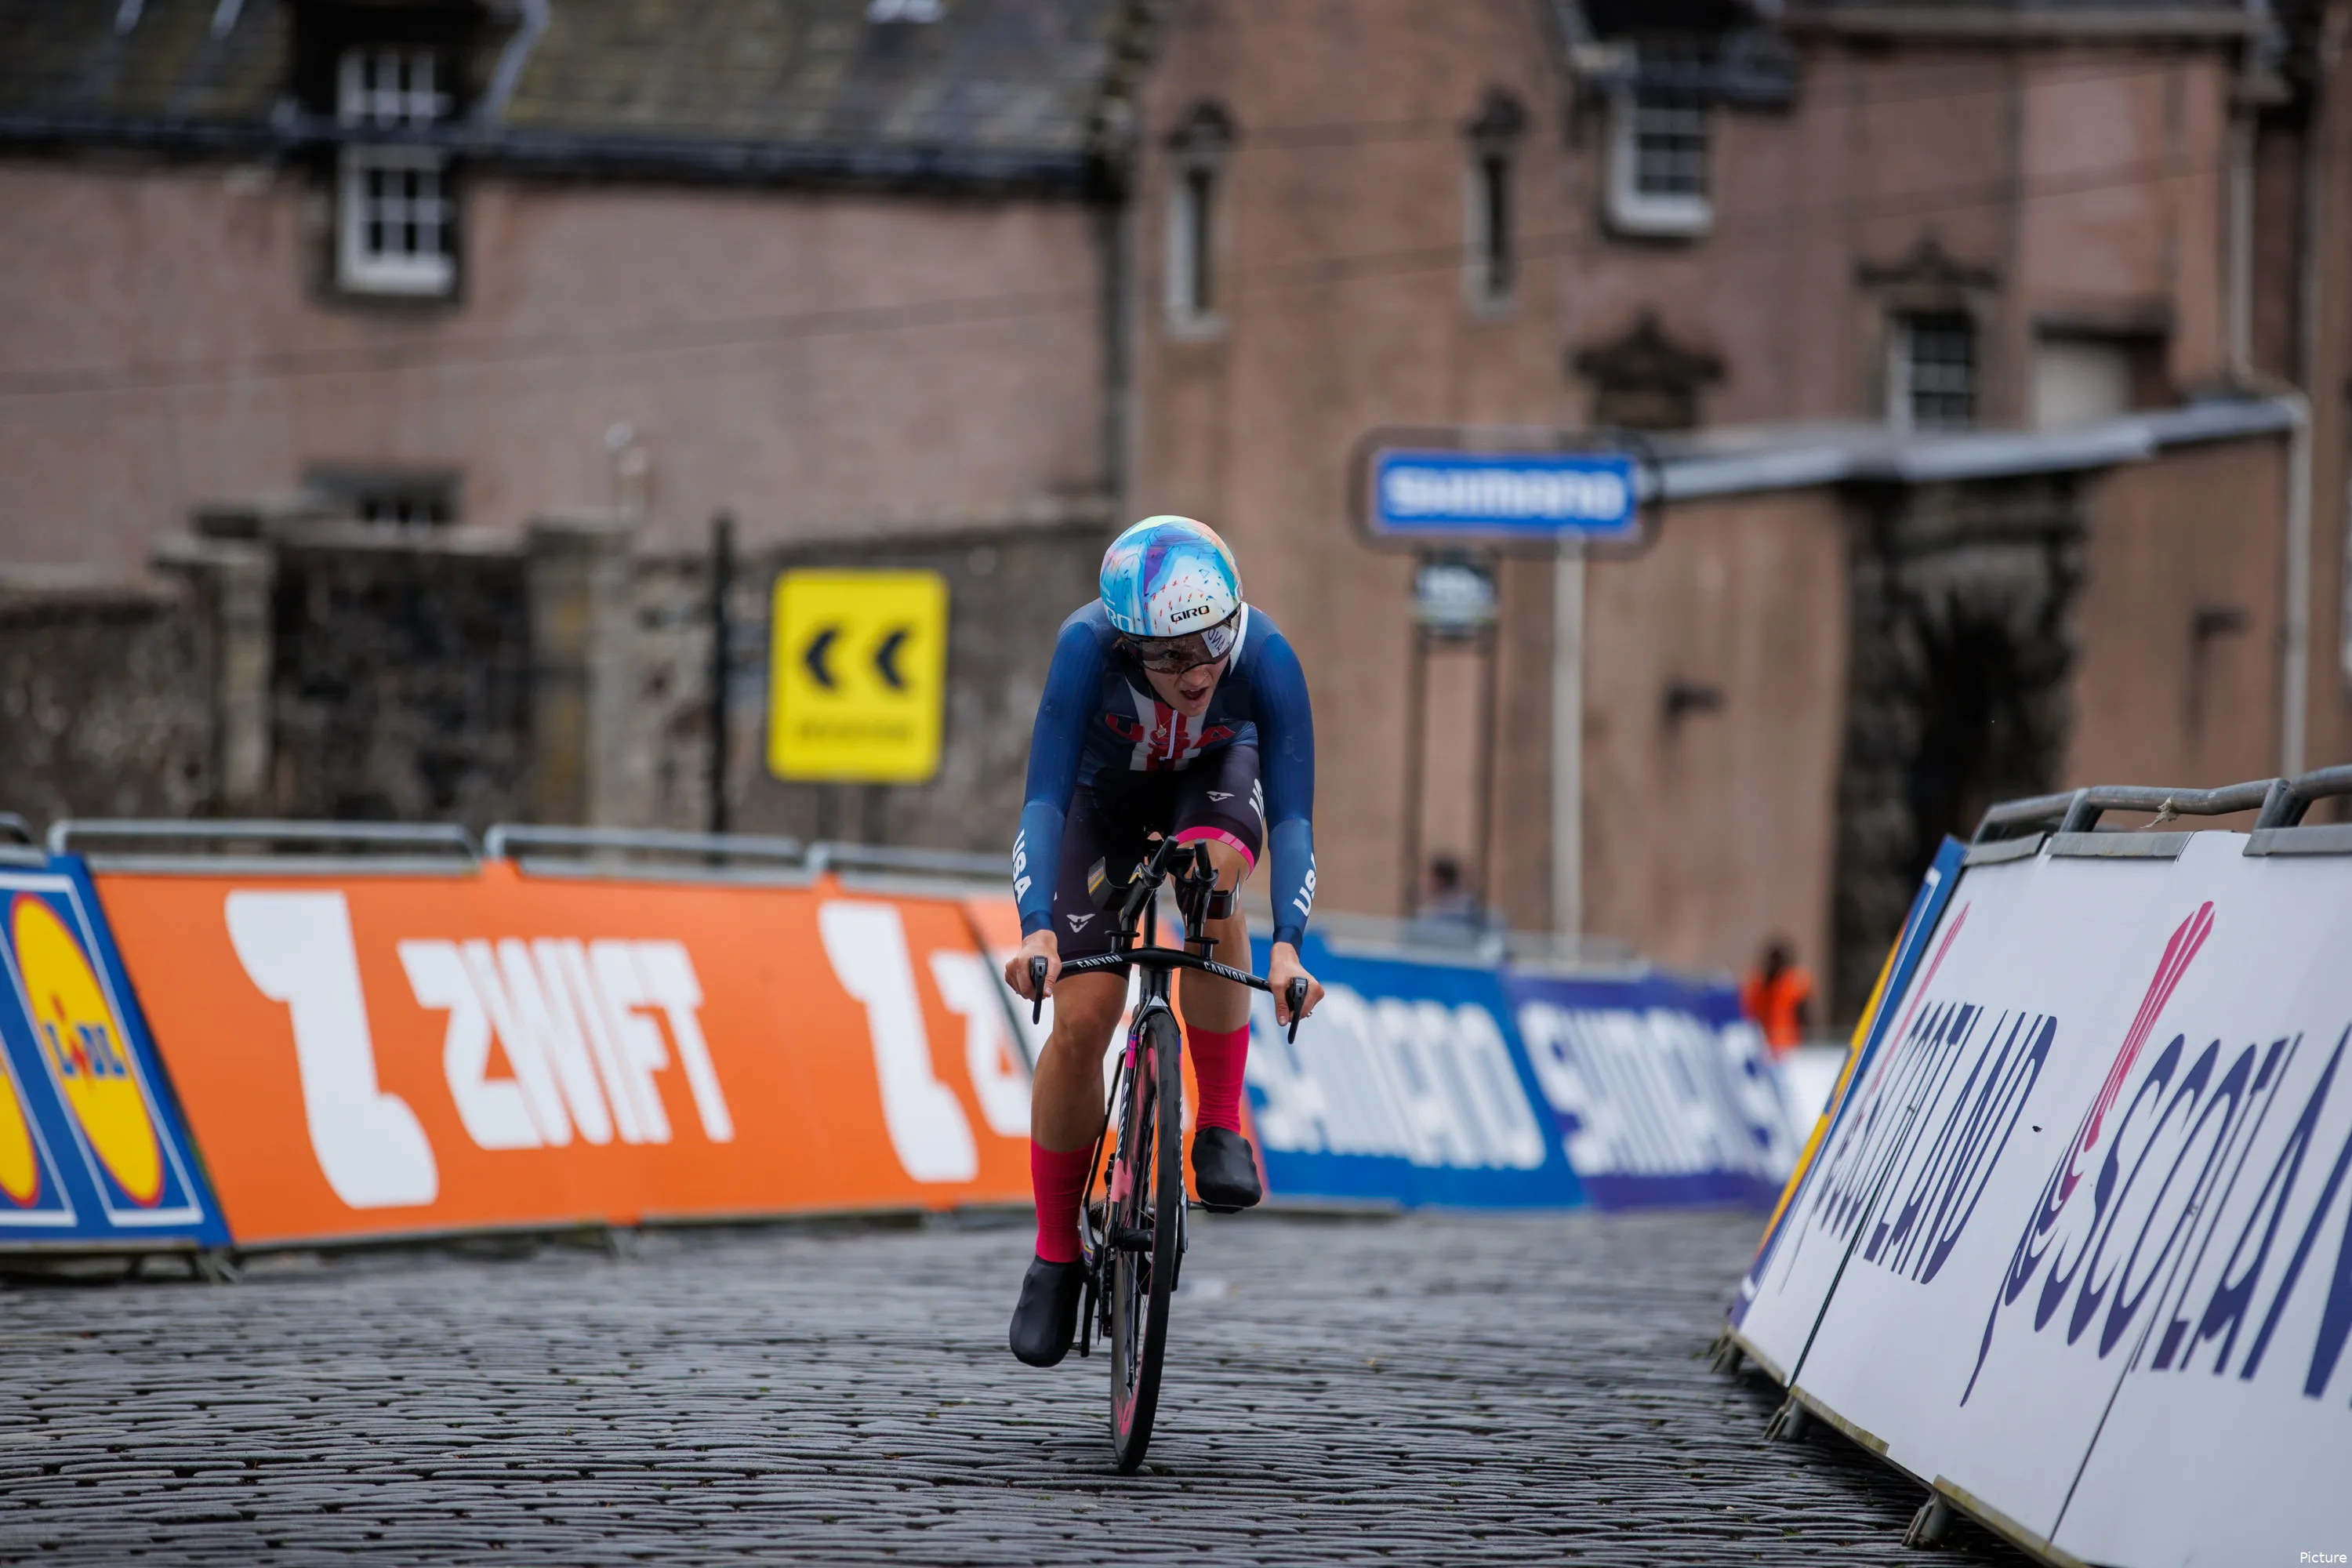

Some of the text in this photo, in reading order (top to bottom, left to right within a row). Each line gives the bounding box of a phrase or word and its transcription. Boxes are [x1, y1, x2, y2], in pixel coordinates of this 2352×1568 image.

[1170, 604, 1210, 623] GIRO
[1105, 713, 1236, 751] USA
[1012, 828, 1033, 905] USA
[1076, 954, 1123, 968] CANYON
[1203, 961, 1247, 983] CANYON
[395, 936, 735, 1150] ZWIFT
[2035, 1022, 2352, 1402] SCOTLAN
